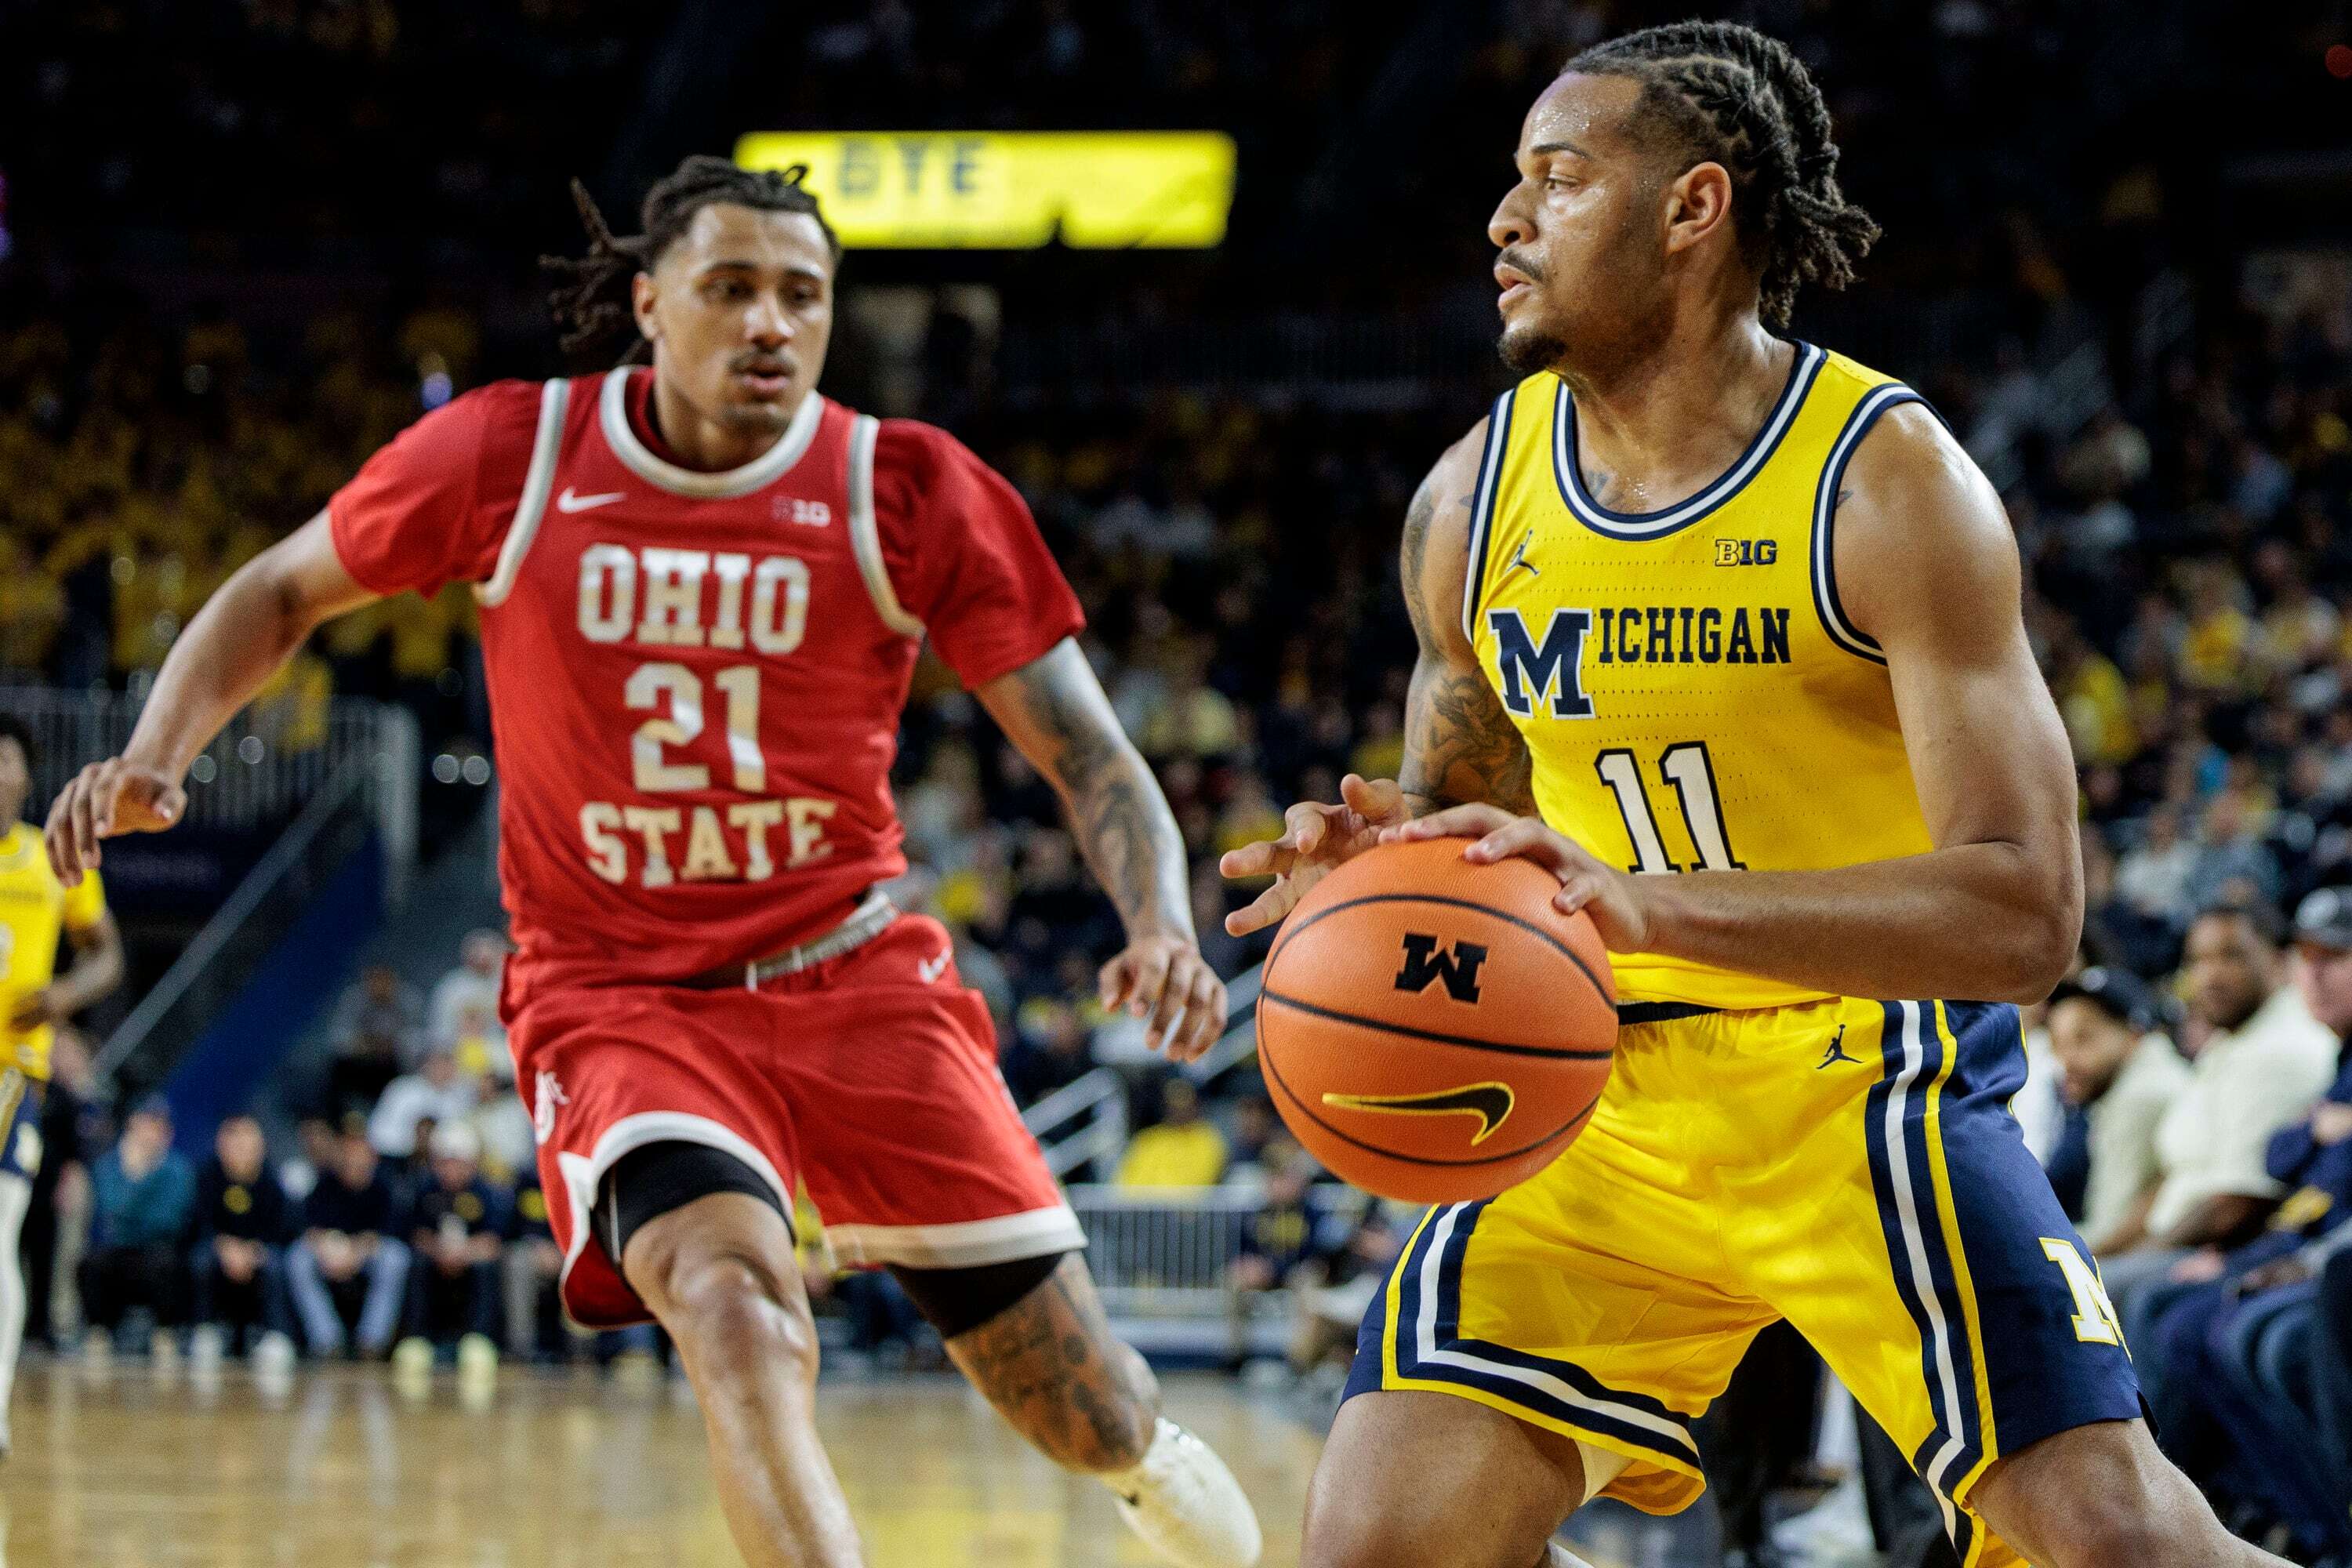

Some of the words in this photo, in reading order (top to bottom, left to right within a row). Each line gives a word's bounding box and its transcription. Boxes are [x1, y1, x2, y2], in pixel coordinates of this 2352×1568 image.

[577, 542, 811, 655] OHIO
[624, 661, 767, 793] 21
[579, 797, 837, 889] STATE
[1594, 740, 1749, 875] 11
